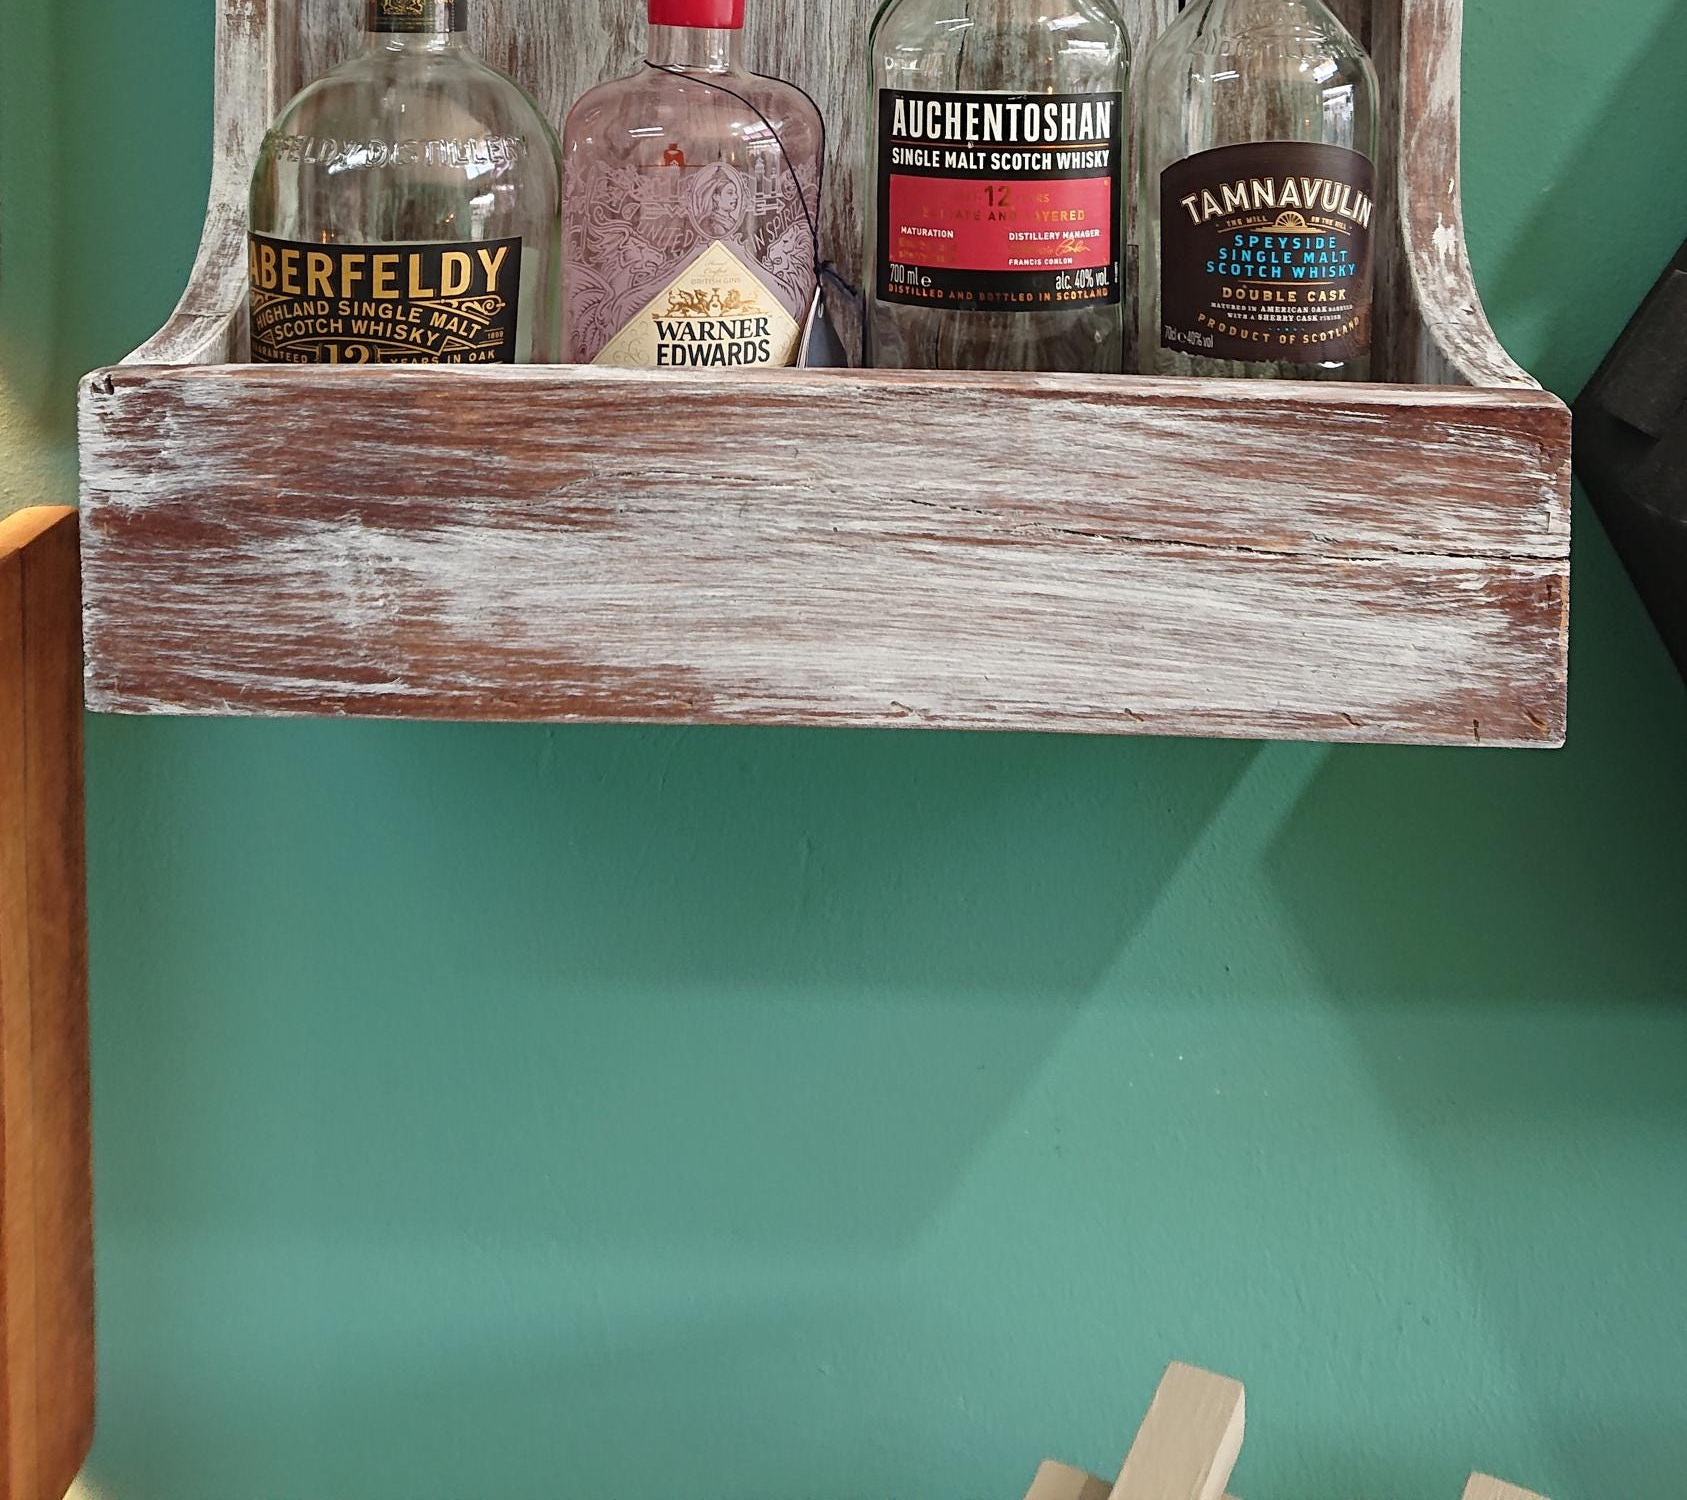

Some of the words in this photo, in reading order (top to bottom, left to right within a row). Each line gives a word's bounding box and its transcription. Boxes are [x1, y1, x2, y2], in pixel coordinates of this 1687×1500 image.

[892, 98, 1111, 143] AUCHENTOSHAN
[892, 147, 940, 168] SINGLE
[945, 152, 985, 170] MALT
[991, 153, 1051, 171] SCOTCH
[1056, 150, 1110, 170] WHISKY
[984, 185, 1011, 208] 12
[1180, 177, 1374, 229] TAMNAVULIN
[1030, 209, 1086, 221] YERED
[901, 226, 954, 238] MATURATION
[1008, 232, 1060, 240] DISTILLERY
[1062, 229, 1100, 239] MANAGER
[1234, 234, 1337, 249] SPEYSIDE
[1008, 258, 1042, 266] FRANCIS
[1044, 257, 1073, 265] CONLON
[1218, 248, 1293, 264] SINGLE
[1303, 251, 1348, 264] MALT
[251, 240, 508, 299] ABERFELDY
[889, 263, 905, 284] 700
[907, 266, 919, 286] ml
[1055, 270, 1072, 290] alc.
[1074, 268, 1094, 288] 40%
[1096, 266, 1110, 286] vol.
[1206, 261, 1282, 278] SCOTCH
[1291, 263, 1356, 278] WHISKY
[888, 283, 944, 298] DISTILLED
[948, 290, 973, 300] AND
[978, 292, 1034, 302] BOTTLED
[1039, 292, 1051, 302] IN
[1056, 287, 1109, 301] SCOTLAND
[1222, 286, 1298, 302] DOUBLE
[1307, 289, 1347, 303] CASK
[1210, 301, 1247, 311] MATURED
[1260, 305, 1309, 314] AMERICAN
[1311, 305, 1328, 313] OAK
[1258, 313, 1295, 322] SHERRY
[1296, 314, 1319, 322] CASK
[256, 300, 330, 328] HIGHLAND
[338, 300, 424, 324] SINGLE
[430, 310, 482, 340] MALT
[653, 317, 772, 343] WARNER
[1198, 313, 1271, 343] PRODUCT
[1280, 334, 1296, 345] OF
[1303, 316, 1360, 344] SCOTLAND
[274, 318, 344, 341] SCOTCH
[352, 319, 441, 348] WHISKY
[447, 354, 461, 364] IN
[468, 349, 496, 362] OAK
[656, 338, 771, 367] EDWARDS
